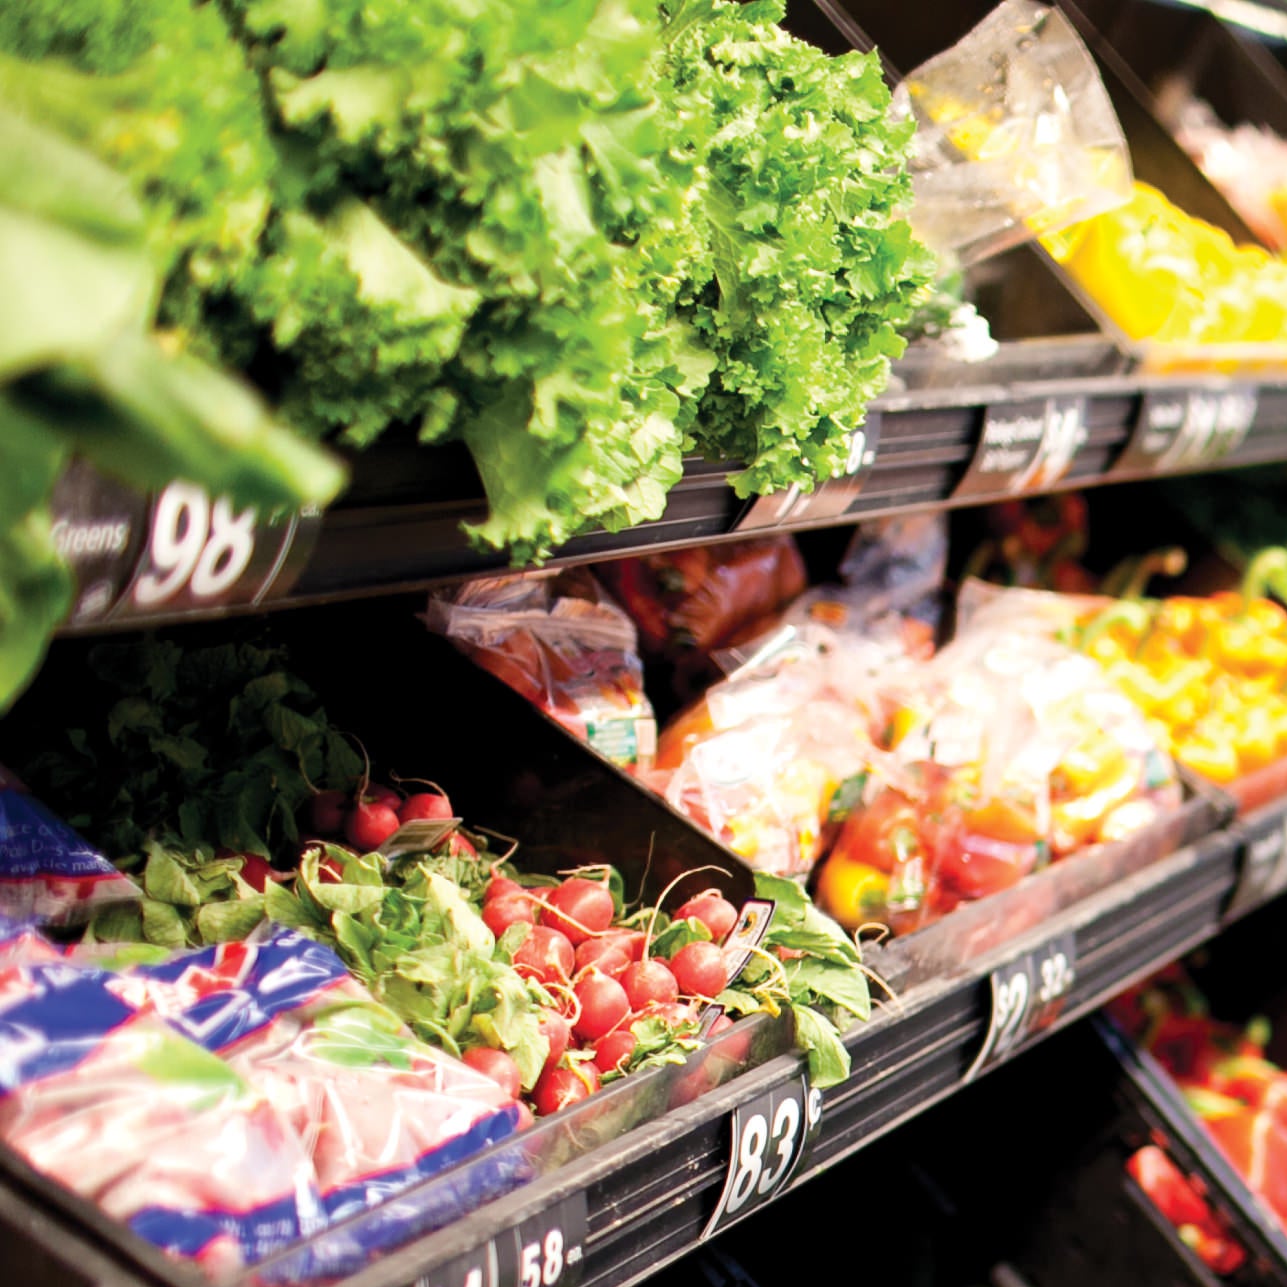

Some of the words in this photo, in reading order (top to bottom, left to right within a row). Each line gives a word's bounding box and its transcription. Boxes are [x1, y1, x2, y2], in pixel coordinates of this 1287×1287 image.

[49, 518, 129, 553] Greens
[134, 481, 257, 606] 98
[726, 1097, 800, 1214] 83
